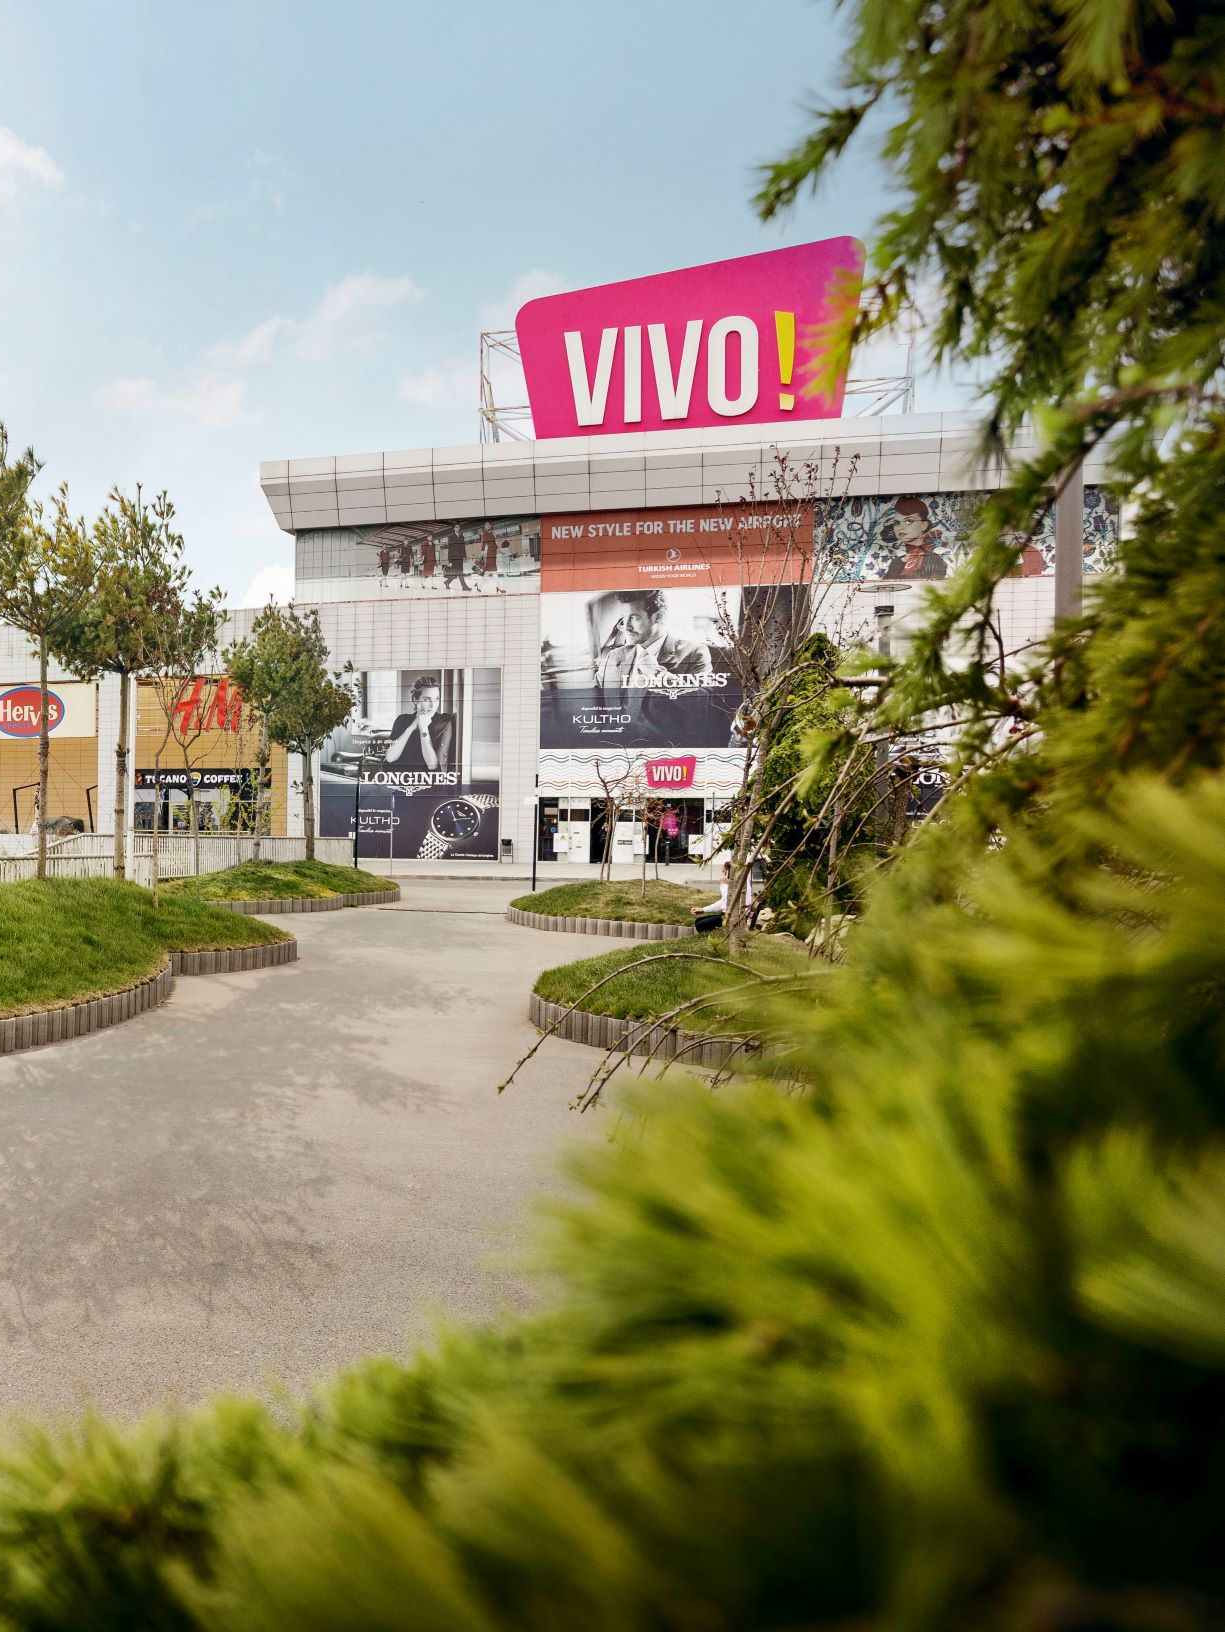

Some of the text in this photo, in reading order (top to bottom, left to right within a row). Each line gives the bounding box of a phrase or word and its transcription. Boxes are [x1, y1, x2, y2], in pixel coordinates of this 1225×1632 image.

[564, 311, 795, 427] VIVO!
[551, 525, 584, 539] NEW
[588, 522, 631, 538] STYLE
[636, 521, 663, 535] FOR
[668, 519, 695, 533] THE
[700, 517, 733, 532] NEW
[637, 563, 711, 573] TURKISH AIRLINES
[621, 672, 728, 689] LONGINES
[572, 714, 631, 724] KULTHO
[203, 774, 243, 785] COFFEE
[362, 771, 458, 785] LONGINES
[652, 765, 687, 782] VIVO!
[350, 816, 401, 825] KULTHO
